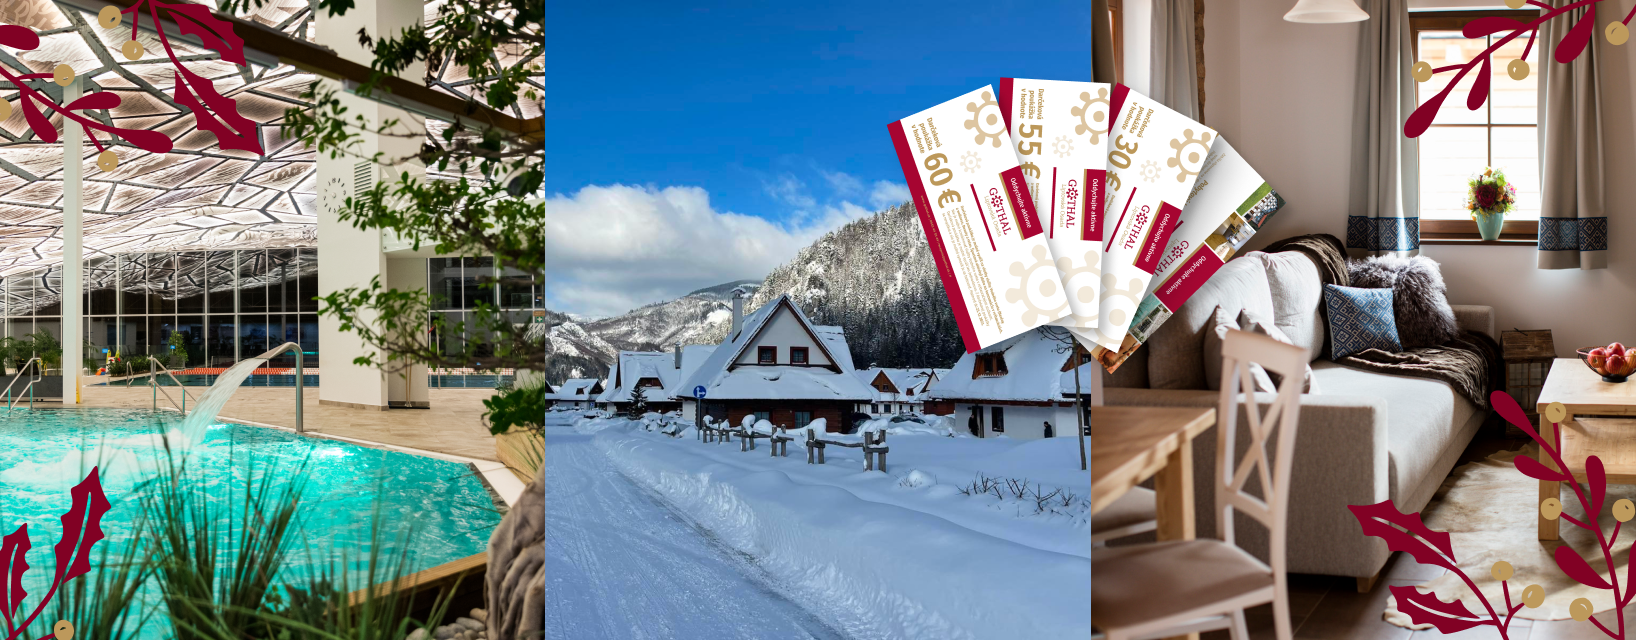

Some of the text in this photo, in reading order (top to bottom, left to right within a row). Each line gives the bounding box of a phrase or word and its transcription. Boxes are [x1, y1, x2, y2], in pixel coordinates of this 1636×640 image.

[1019, 93, 1027, 119] hodnote
[1027, 89, 1036, 119] poukážka
[1018, 122, 1043, 156] 55
[1107, 134, 1138, 169] 30
[923, 152, 953, 186] 60
[1019, 161, 1041, 180] €
[1105, 170, 1121, 192] €
[937, 188, 962, 209] €
